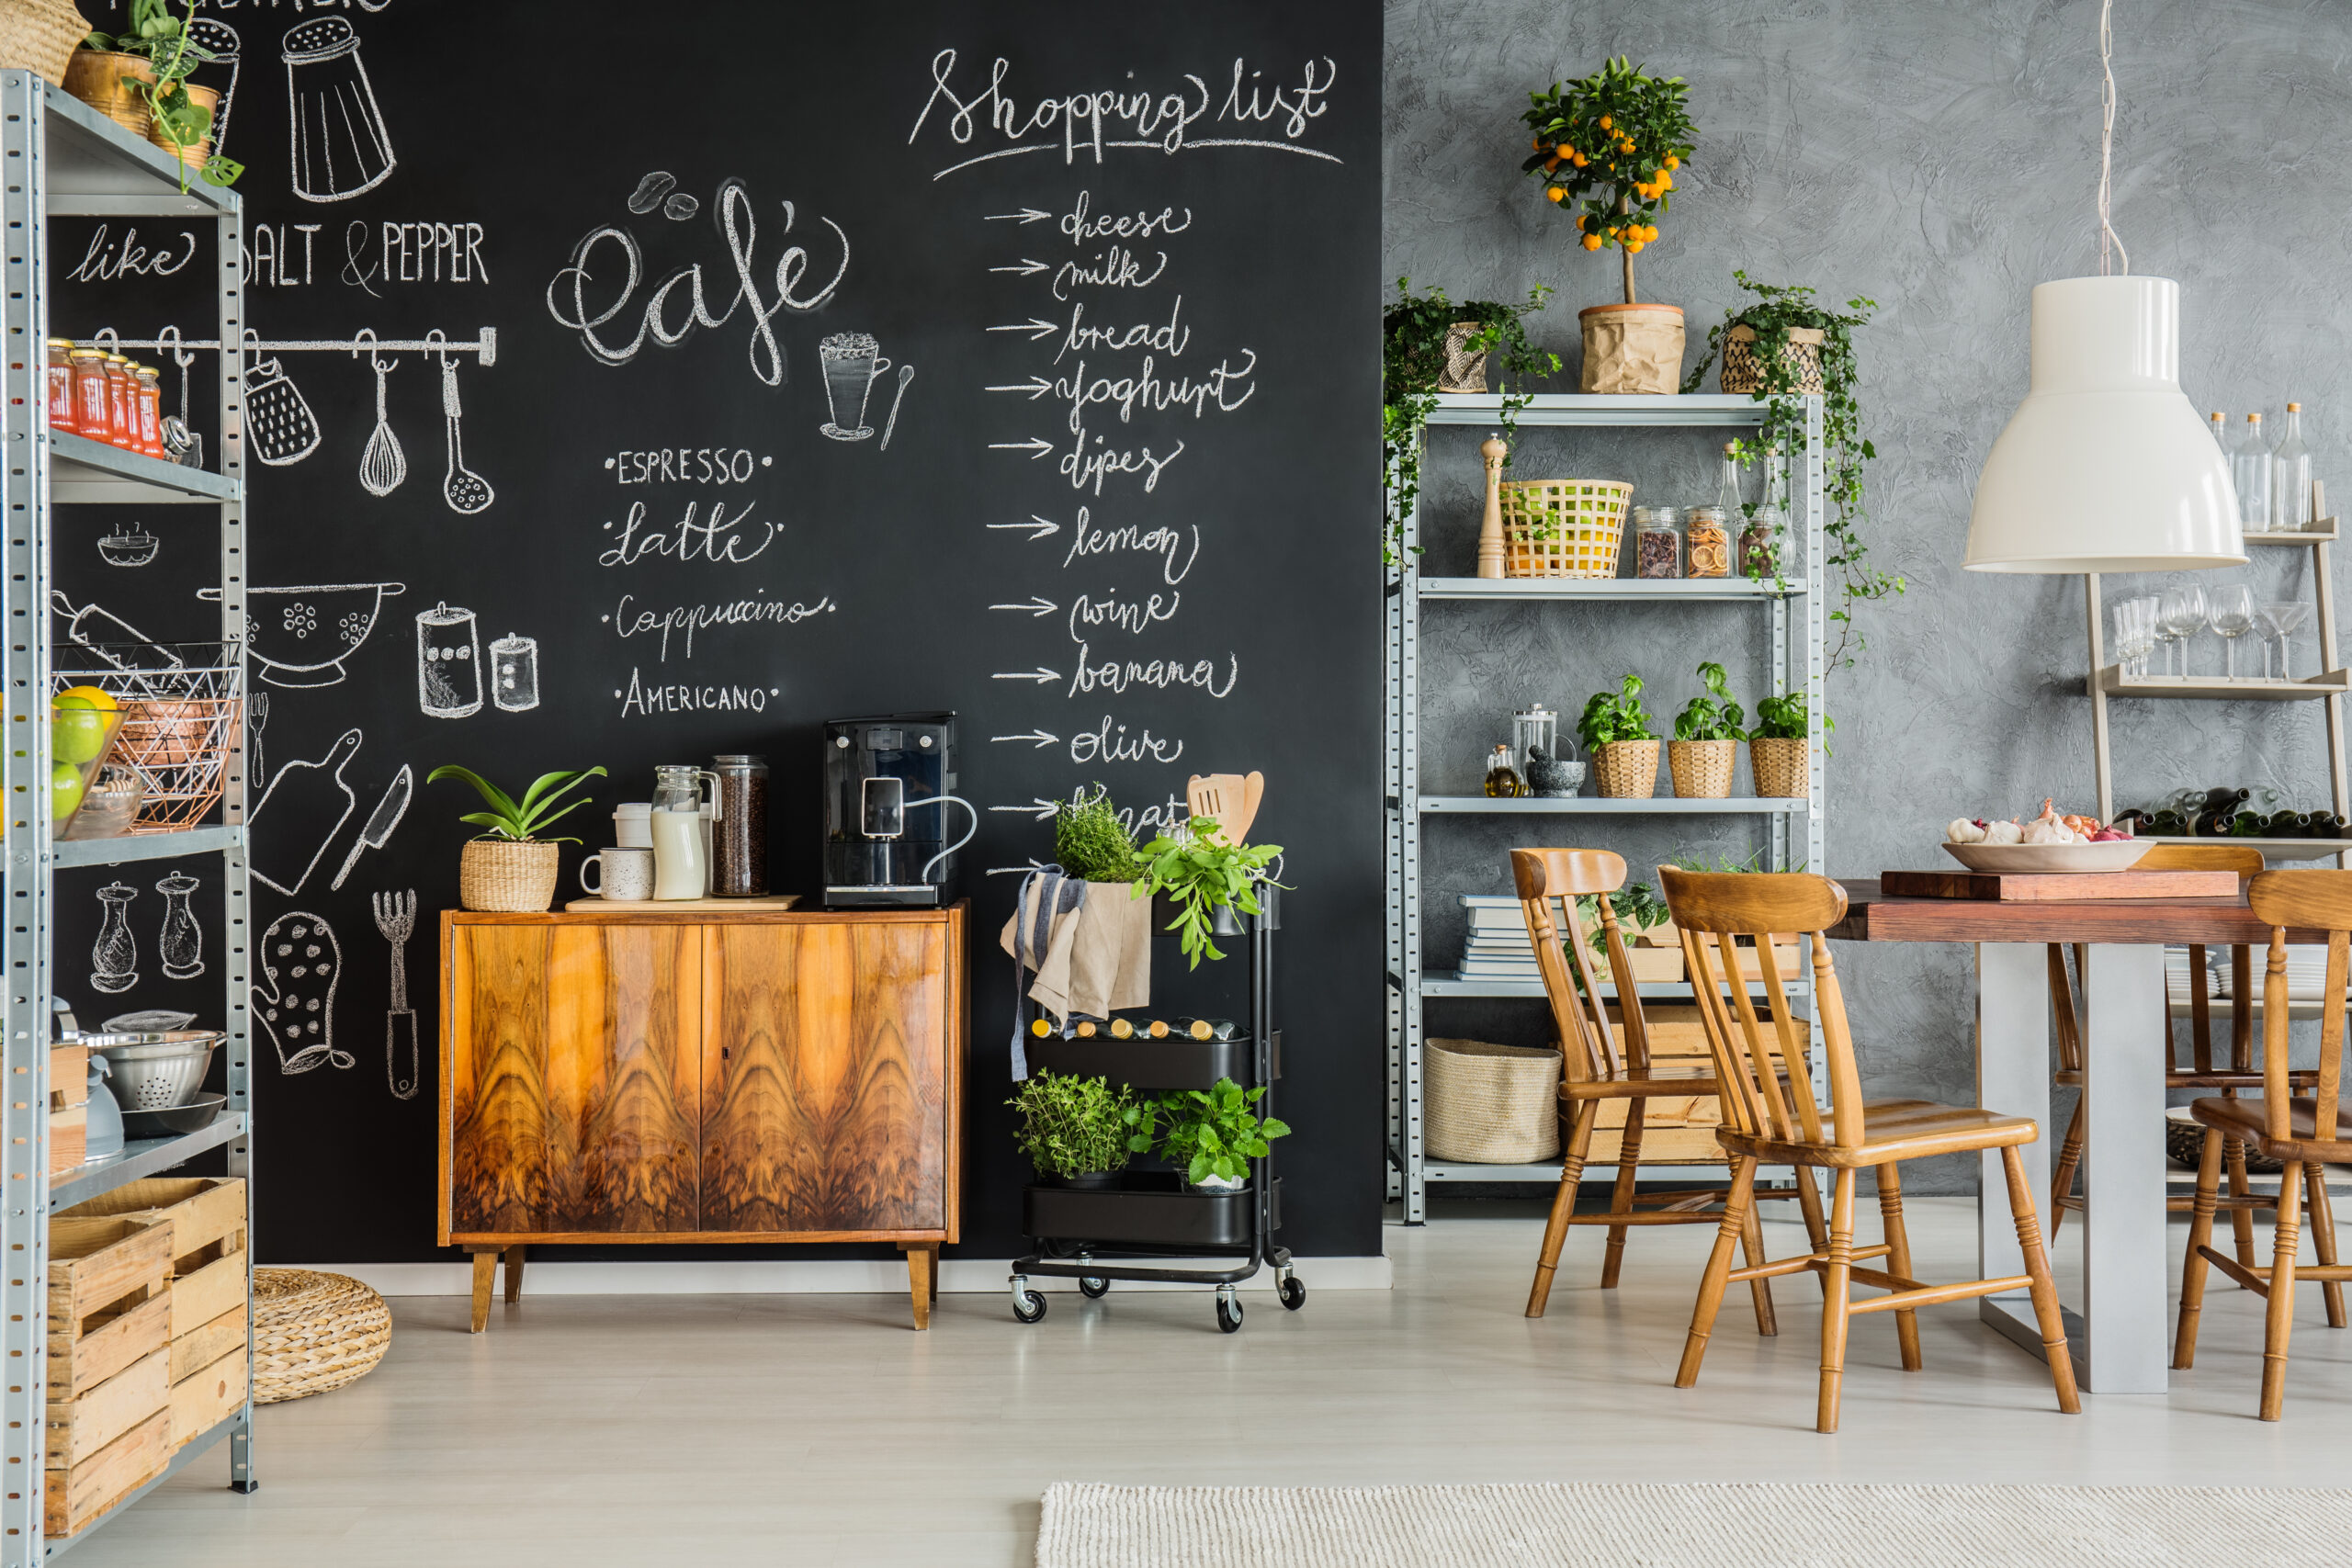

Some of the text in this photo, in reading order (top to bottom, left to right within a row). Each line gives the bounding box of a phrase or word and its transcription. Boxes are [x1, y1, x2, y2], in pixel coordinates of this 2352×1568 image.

[908, 49, 1336, 164] Shopping list
[1060, 190, 1192, 245] cheese
[67, 220, 489, 299] like ALT & PEPPER
[547, 186, 850, 387] Café
[1053, 245, 1168, 301] milk
[1053, 294, 1191, 365] bread
[1056, 348, 1257, 434] yoghurt
[618, 448, 754, 485] ESPRESSO
[1060, 427, 1185, 496] dipes
[599, 501, 774, 567] Latte
[1063, 506, 1200, 585] lemon
[616, 587, 829, 662] Cappuccino
[1069, 587, 1181, 644] wine
[1069, 643, 1238, 698] banana
[1070, 714, 1184, 764] olive
